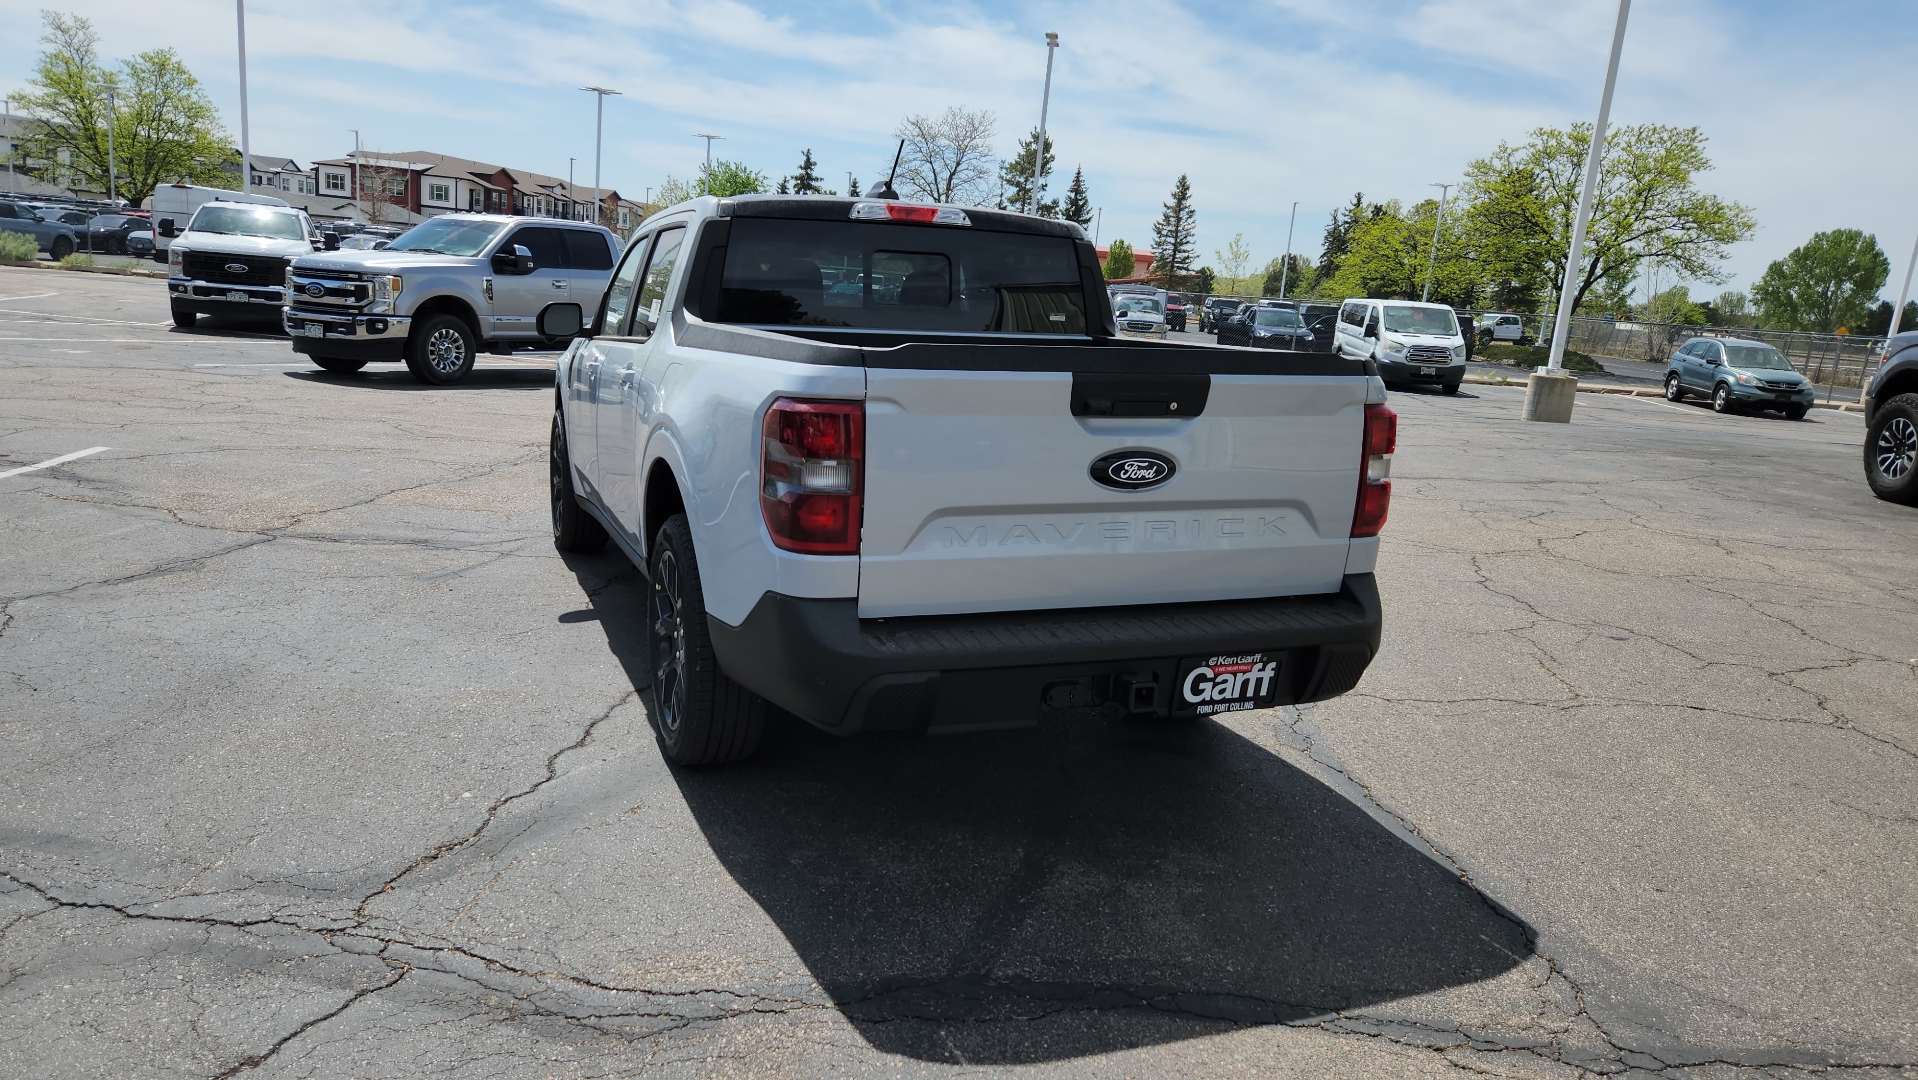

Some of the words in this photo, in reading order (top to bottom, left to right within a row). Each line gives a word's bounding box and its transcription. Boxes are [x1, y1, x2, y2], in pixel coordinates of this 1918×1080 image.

[1120, 461, 1158, 479] Ford
[942, 516, 1286, 548] MAVERICK
[1217, 655, 1237, 665] Ken
[1237, 653, 1262, 664] Garff
[1182, 661, 1277, 703] Garff
[1196, 704, 1213, 715] FORD
[1213, 703, 1230, 713] FORT
[1229, 701, 1255, 711] COLLINS
